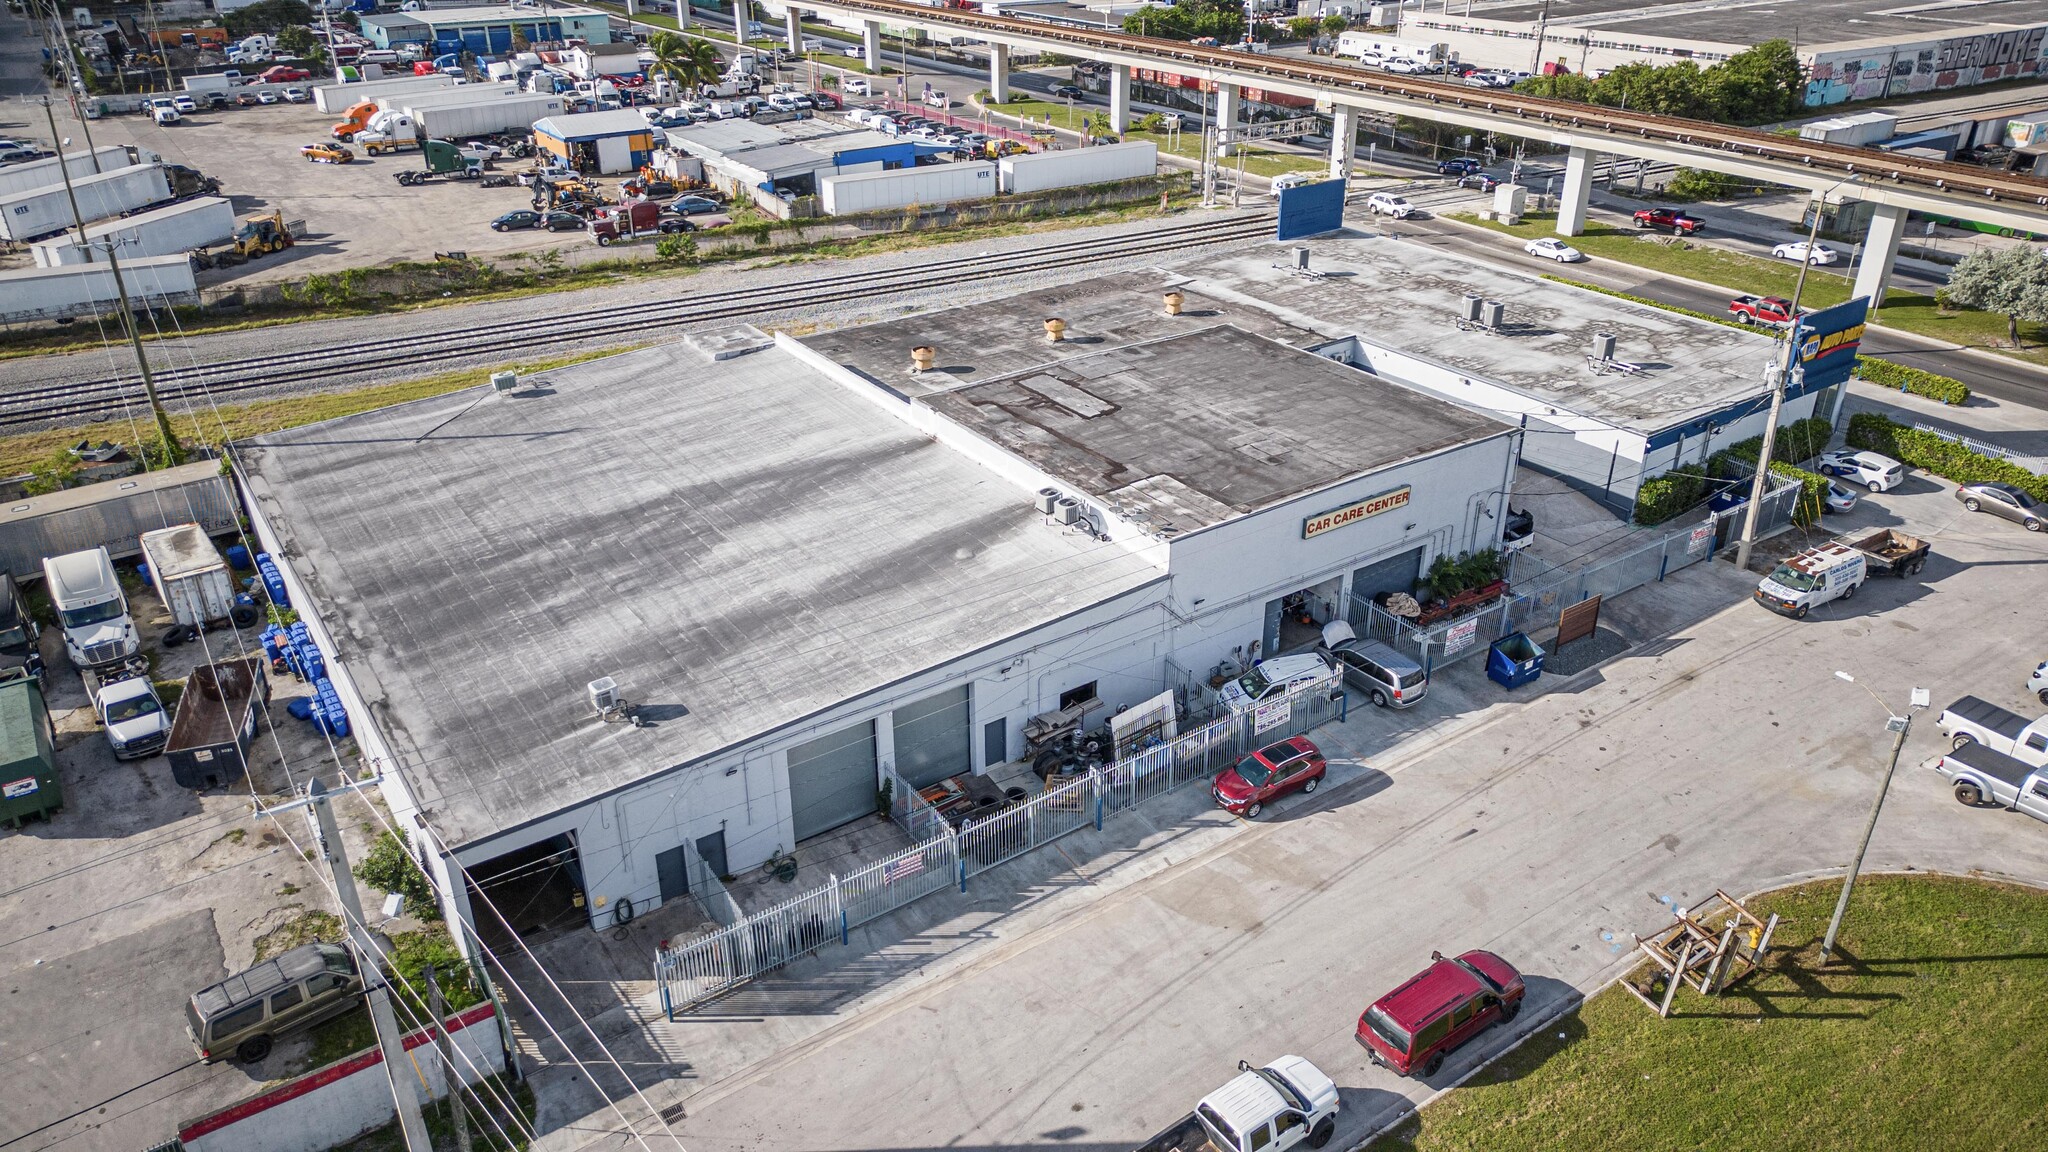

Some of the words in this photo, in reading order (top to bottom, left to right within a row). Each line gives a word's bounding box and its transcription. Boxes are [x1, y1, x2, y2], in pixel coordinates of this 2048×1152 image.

[1819, 331, 1843, 351] AUTO
[1307, 518, 1331, 534] CAR
[1333, 506, 1364, 525] CARE
[1366, 491, 1409, 514] CENTER
